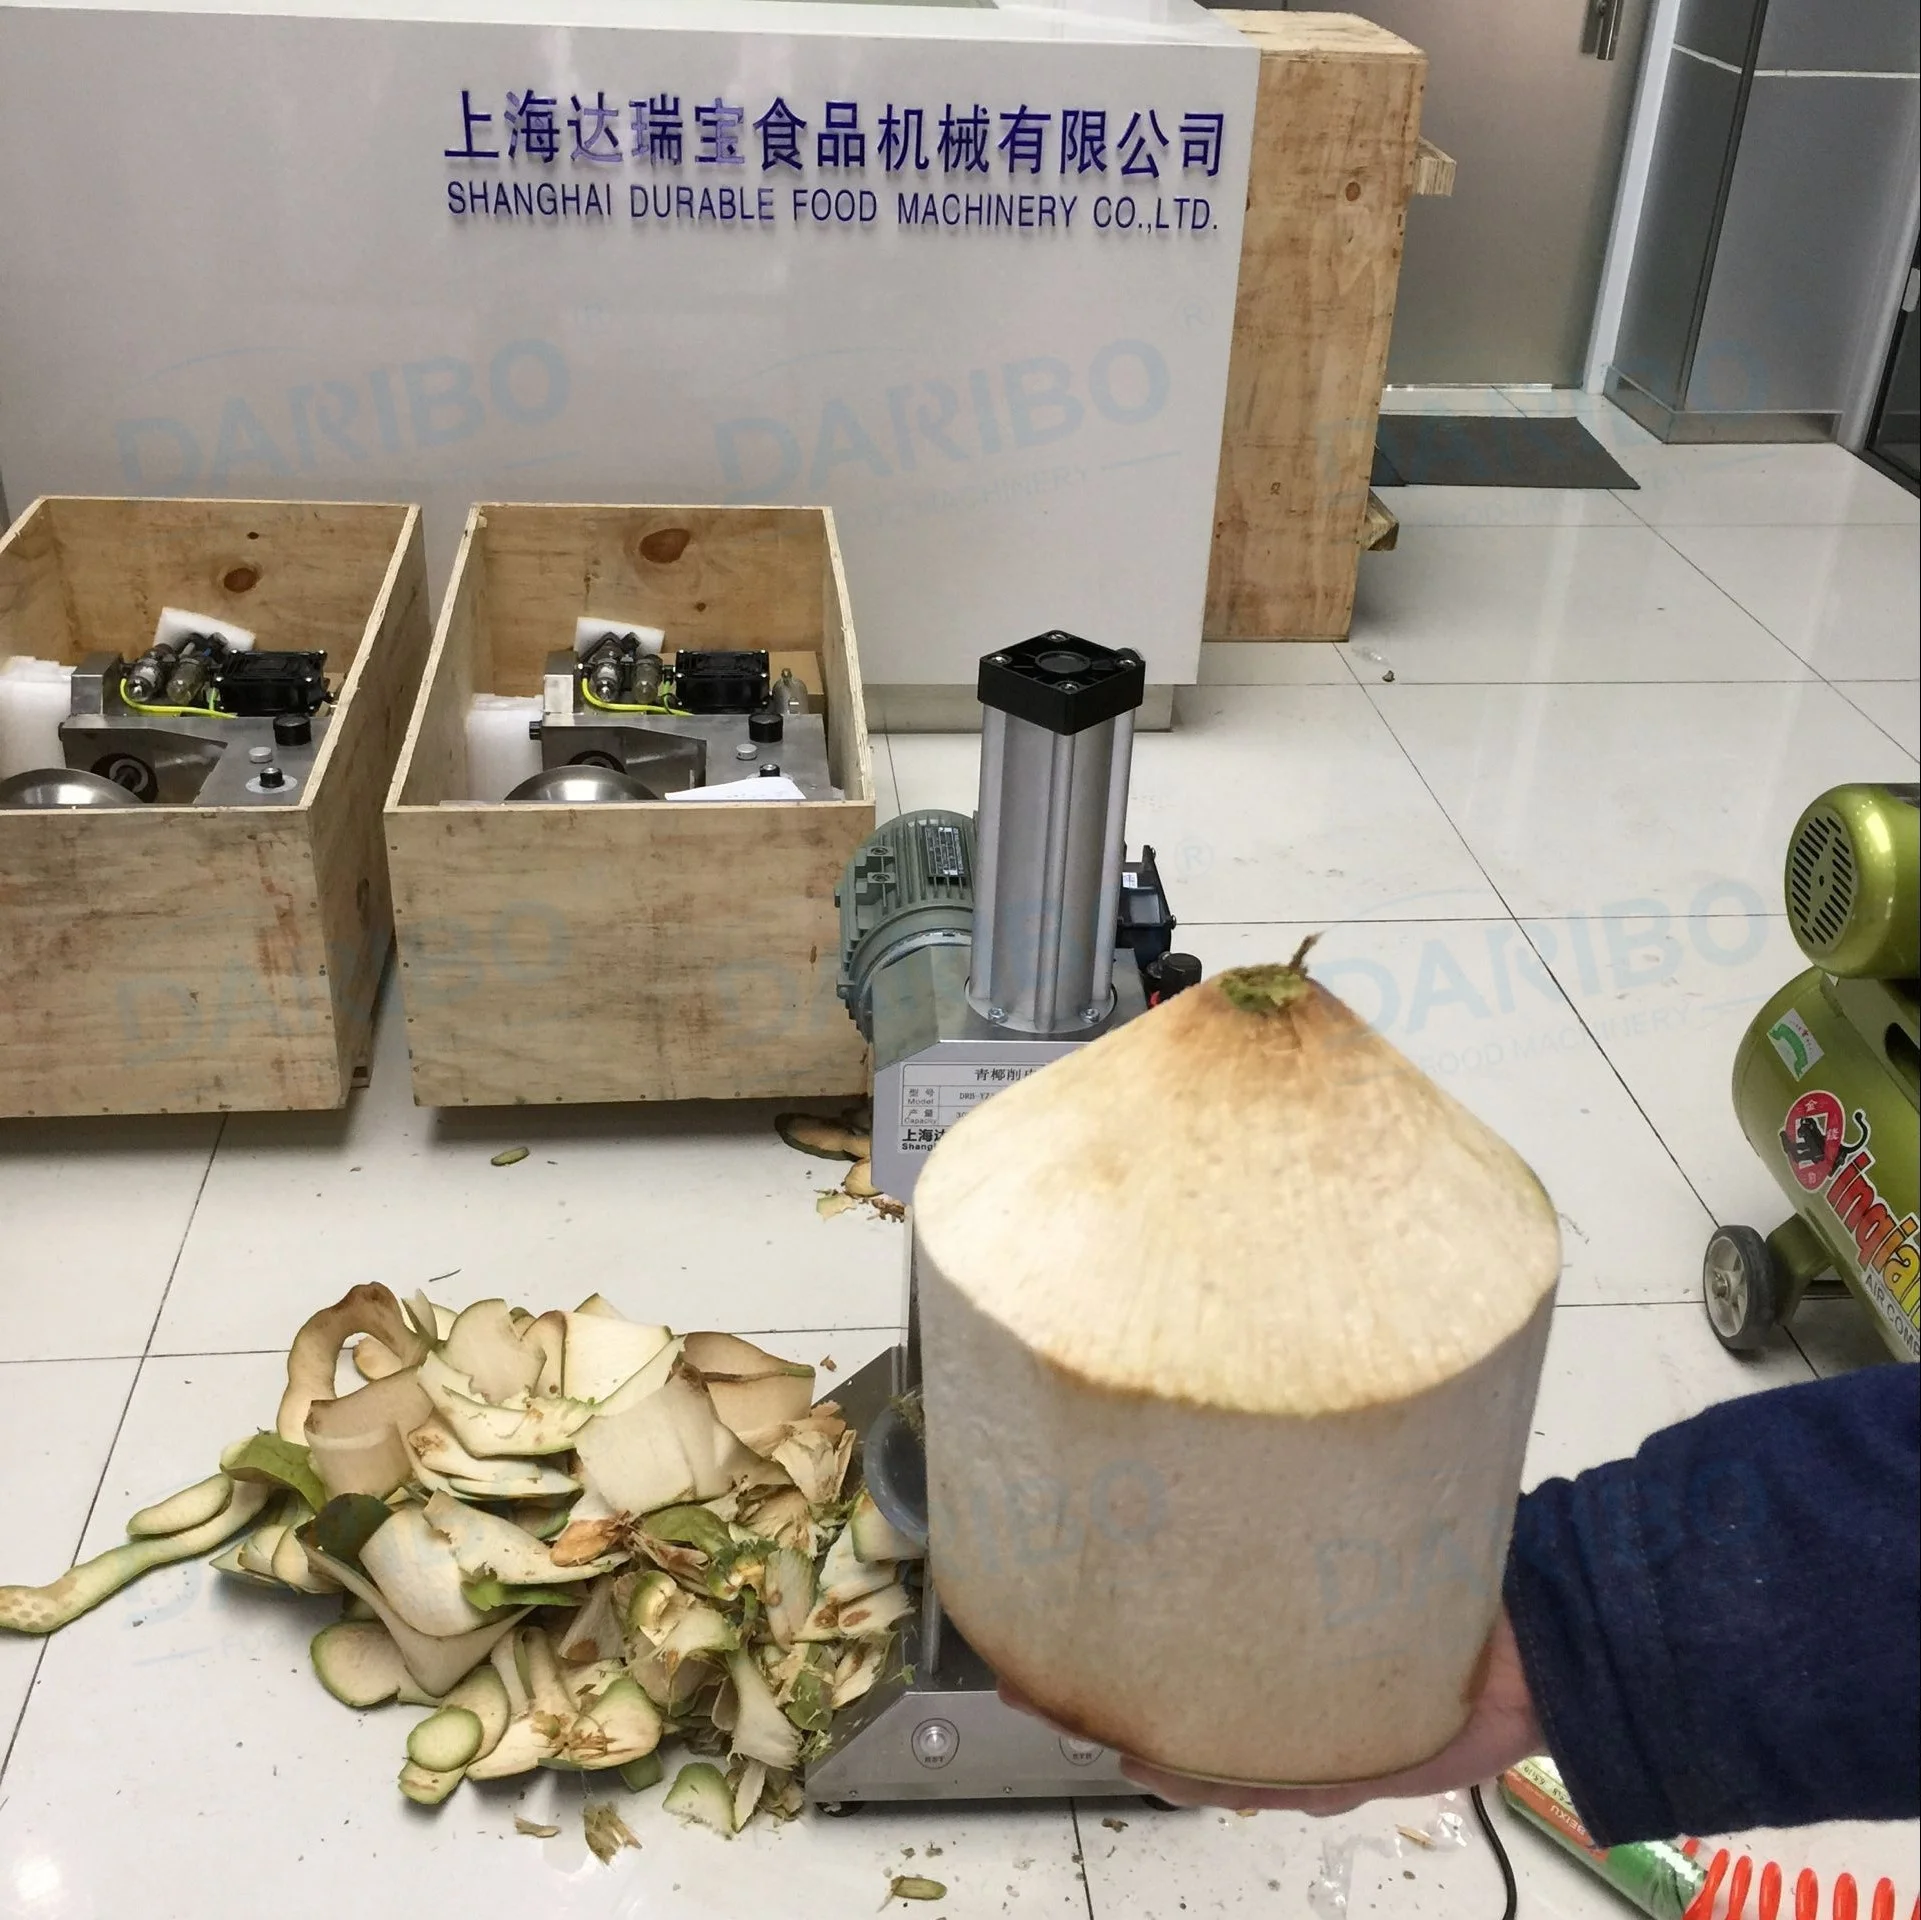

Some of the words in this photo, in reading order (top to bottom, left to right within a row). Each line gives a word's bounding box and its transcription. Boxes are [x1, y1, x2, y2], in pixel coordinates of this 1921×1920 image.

[444, 88, 1224, 179] 上海达瑞宝食品机械有限公司
[447, 181, 612, 217] SHANGHAI
[629, 185, 775, 221] DURABLE
[792, 189, 878, 223] FOOD
[897, 192, 1078, 228] MACHINERY
[902, 1143, 936, 1151] Shang
[1865, 1273, 1886, 1306] AIR
